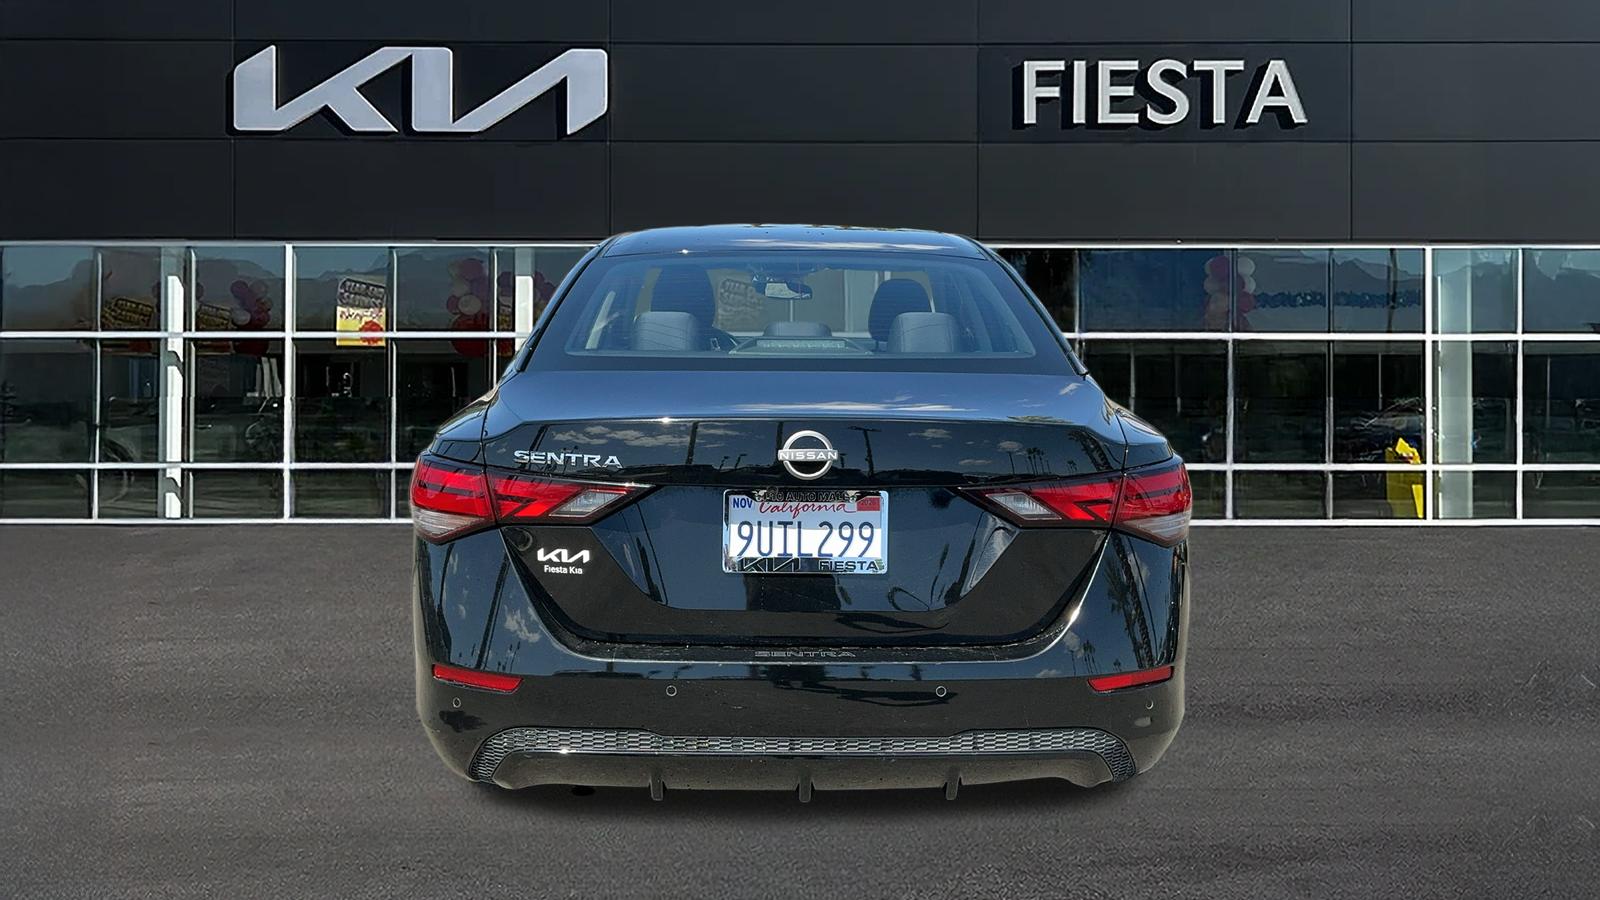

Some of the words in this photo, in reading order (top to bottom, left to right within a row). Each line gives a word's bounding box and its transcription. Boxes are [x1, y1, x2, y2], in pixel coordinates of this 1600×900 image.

[233, 44, 608, 135] KIA
[1023, 58, 1308, 125] FIESTA
[513, 449, 623, 469] SENTRA
[779, 451, 838, 460] NISSAN
[732, 497, 753, 509] NOV
[786, 491, 816, 502] AUTO
[760, 501, 857, 519] California
[737, 521, 874, 558] 9UIL299
[537, 547, 590, 564] KIA
[543, 564, 568, 574] Fiesta
[569, 565, 583, 575] Kia
[819, 559, 879, 571] FIESTA
[754, 650, 857, 658] SENTRA
